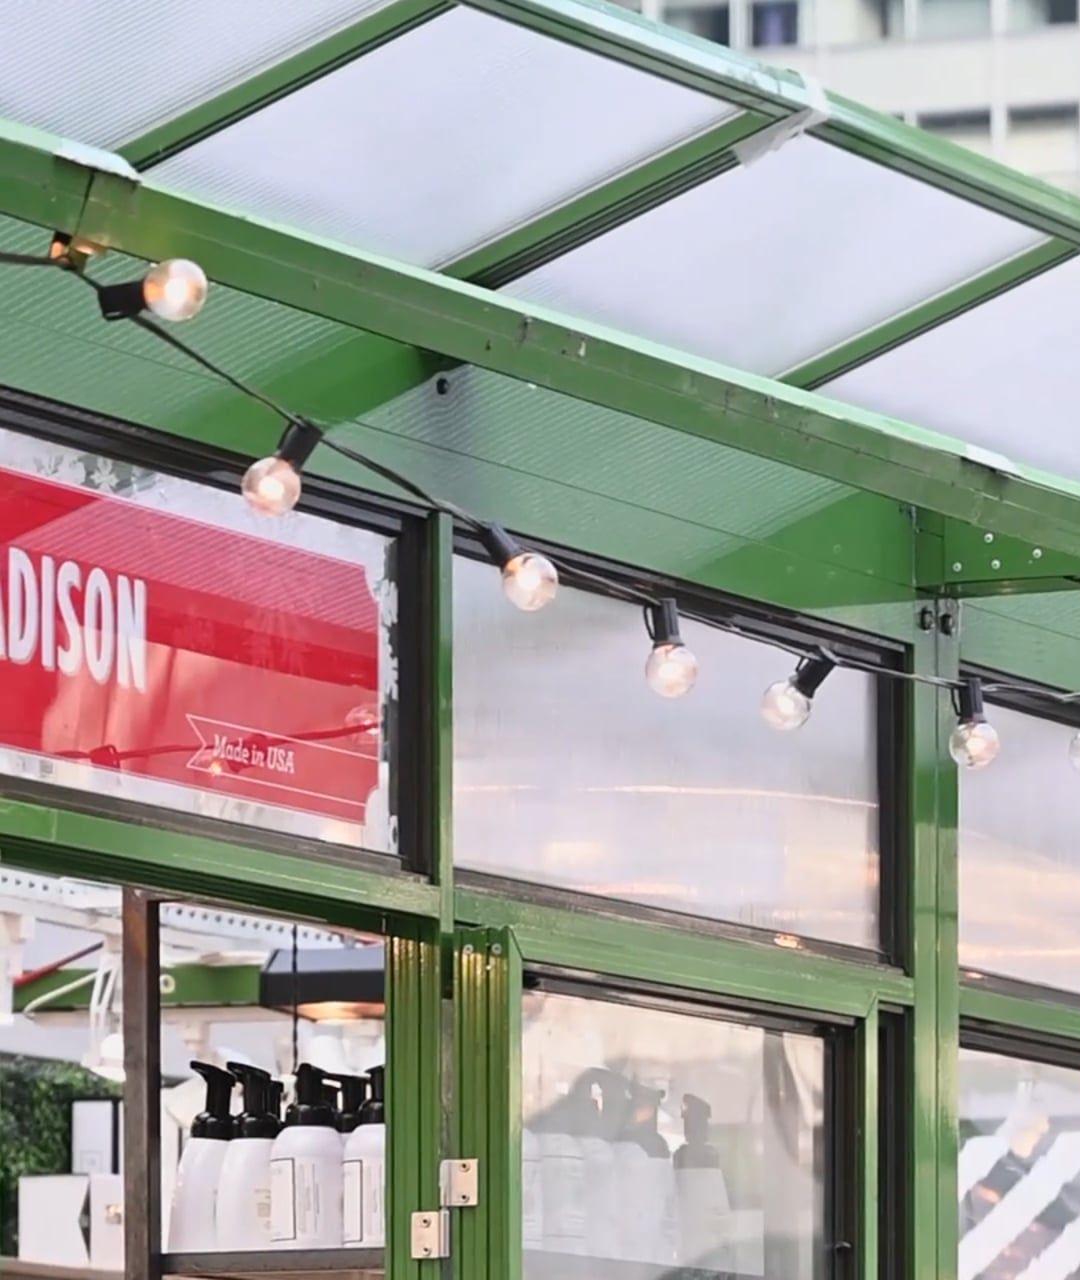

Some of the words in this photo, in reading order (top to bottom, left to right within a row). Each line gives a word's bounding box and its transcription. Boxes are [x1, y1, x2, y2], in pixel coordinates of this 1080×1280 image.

[0, 546, 147, 694] DISON
[213, 734, 249, 764] Made
[251, 744, 265, 767] in
[267, 747, 295, 773] USA
